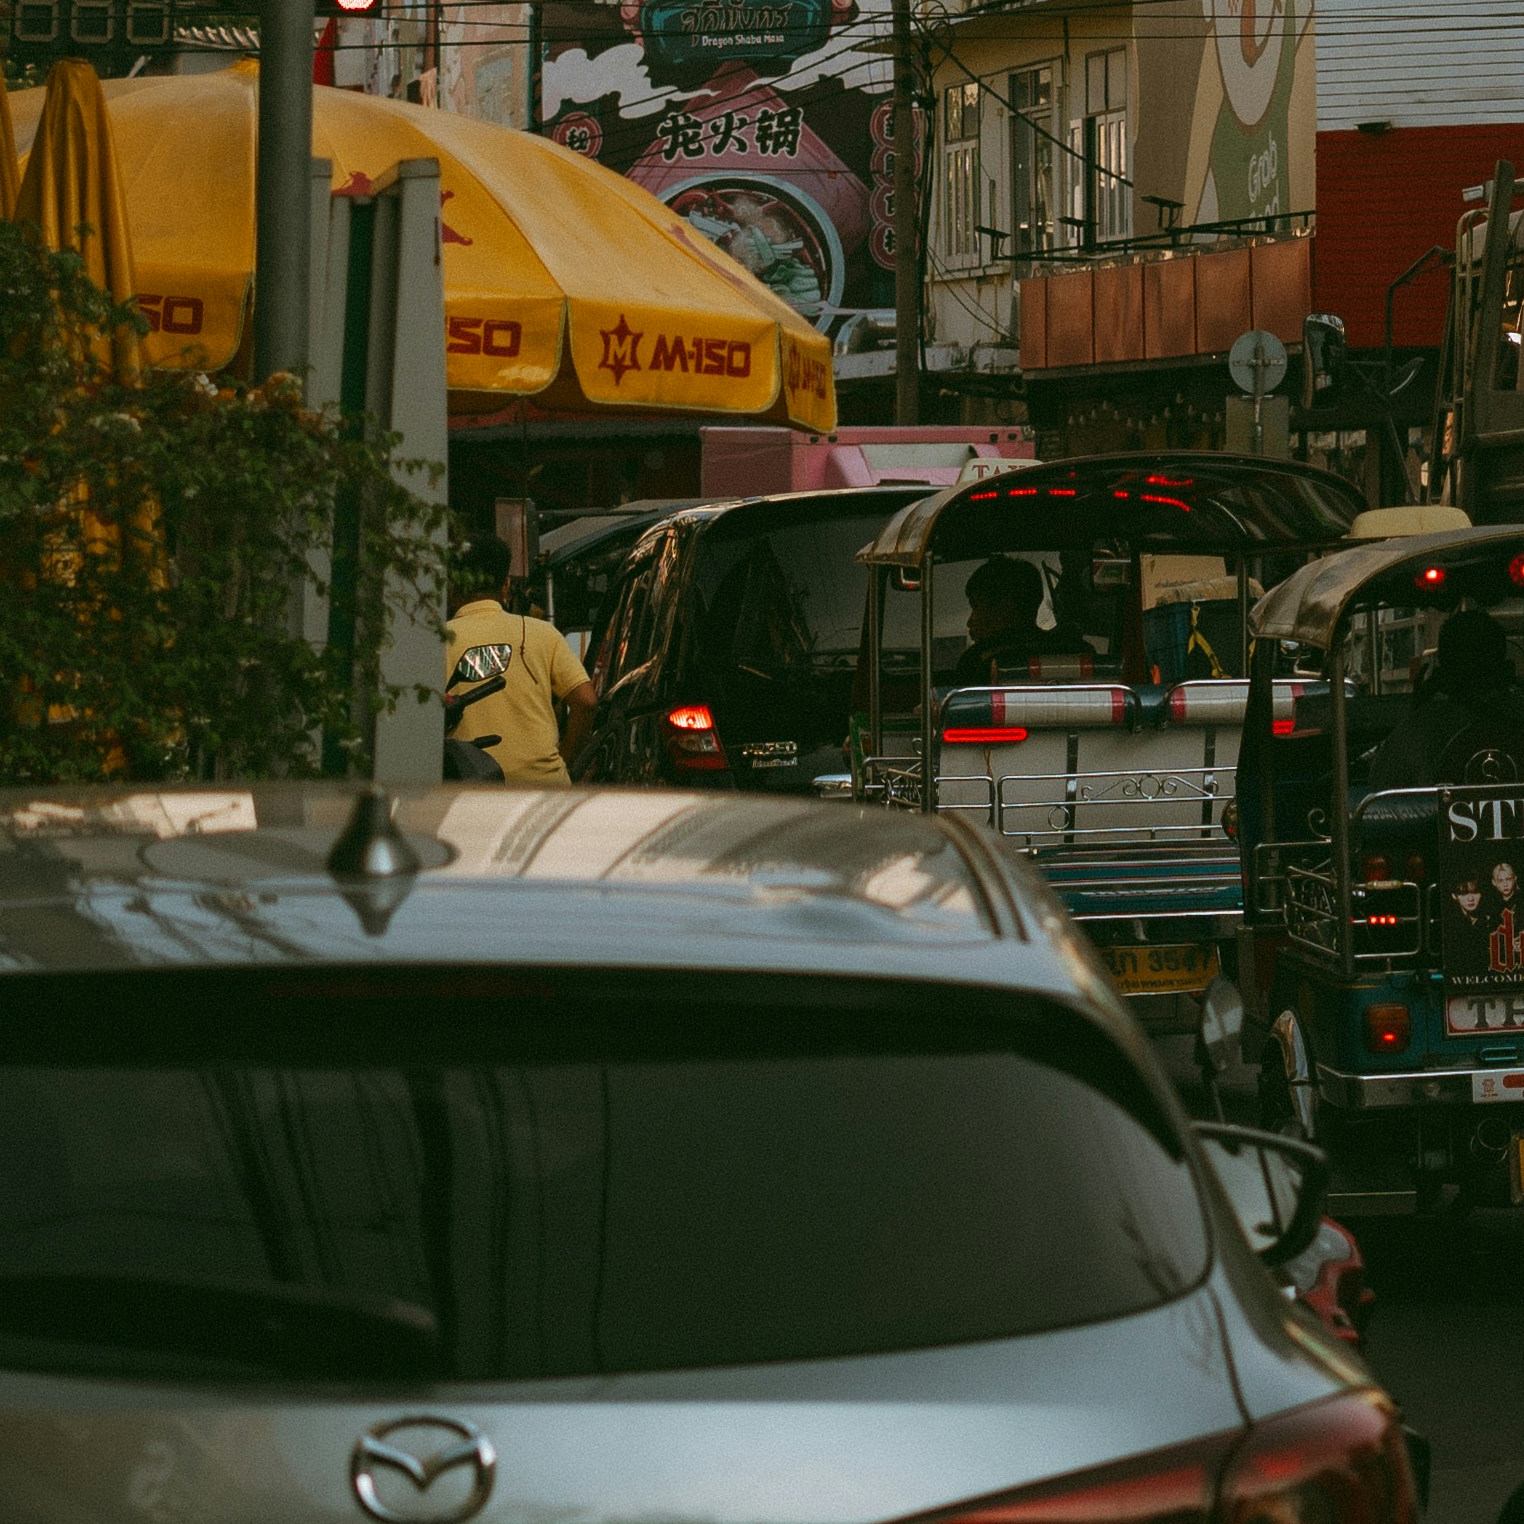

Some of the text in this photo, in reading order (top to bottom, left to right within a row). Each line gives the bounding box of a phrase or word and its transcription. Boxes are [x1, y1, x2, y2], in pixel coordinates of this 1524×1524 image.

[702, 35, 733, 48] Dragon
[735, 34, 761, 45] Shabu
[657, 106, 804, 163] 龙火锅
[648, 333, 752, 378] M-150
